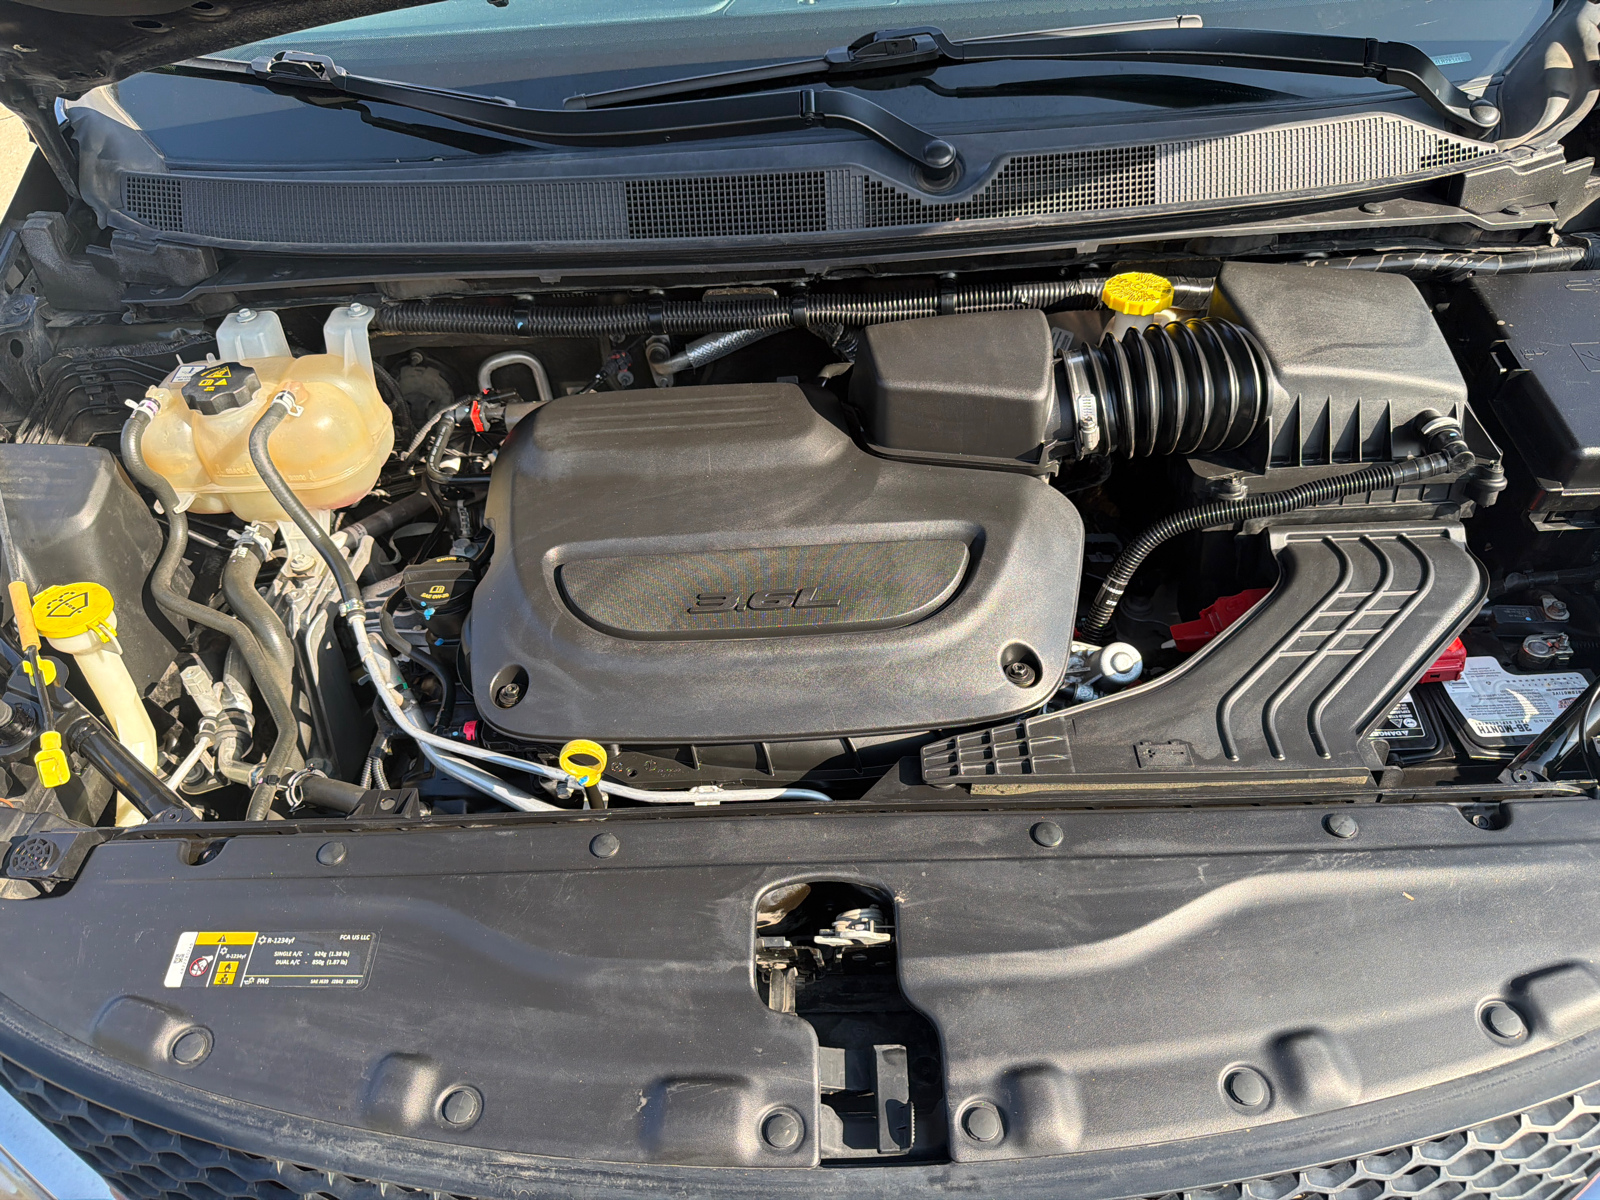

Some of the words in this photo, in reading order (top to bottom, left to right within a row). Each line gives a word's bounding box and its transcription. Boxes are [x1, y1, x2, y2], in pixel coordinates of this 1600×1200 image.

[687, 587, 841, 614] 3.6L
[1478, 723, 1532, 734] 36-MONTH
[266, 937, 296, 945] R-1234yf
[292, 950, 304, 958] A/C
[256, 977, 270, 985] PAG
